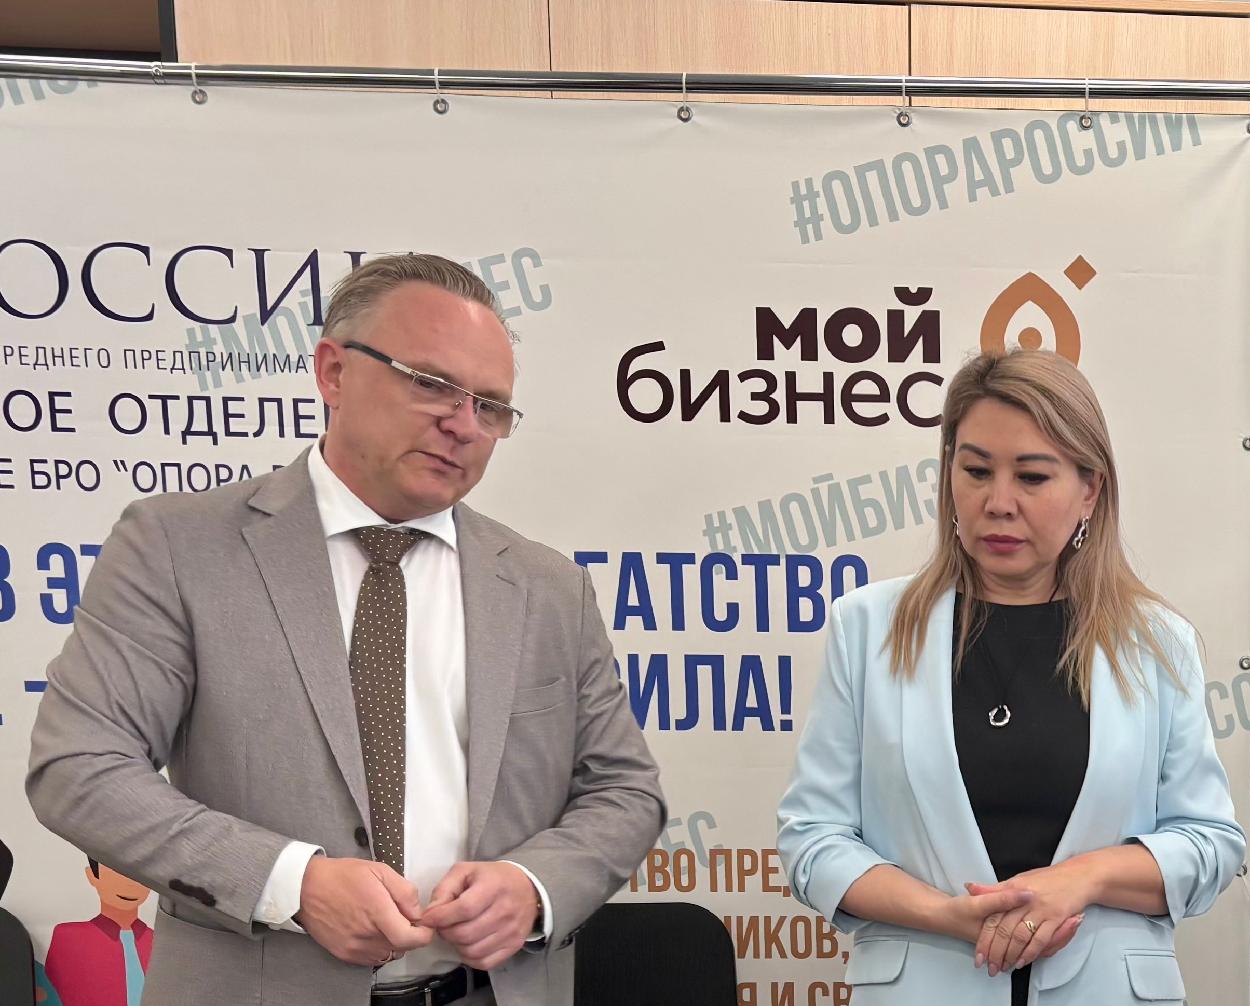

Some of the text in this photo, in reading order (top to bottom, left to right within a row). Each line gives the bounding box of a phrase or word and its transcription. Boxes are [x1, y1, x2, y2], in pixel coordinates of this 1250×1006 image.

[755, 286, 942, 365] мой
[123, 348, 316, 375] ПРЕДПРИНИМА
[616, 340, 945, 428] бизнес
[107, 392, 331, 446] ОТДЕЛЕ
[29, 458, 101, 493] БРО
[613, 652, 794, 733] ИЛА!
[709, 848, 793, 898] ПРЕ
